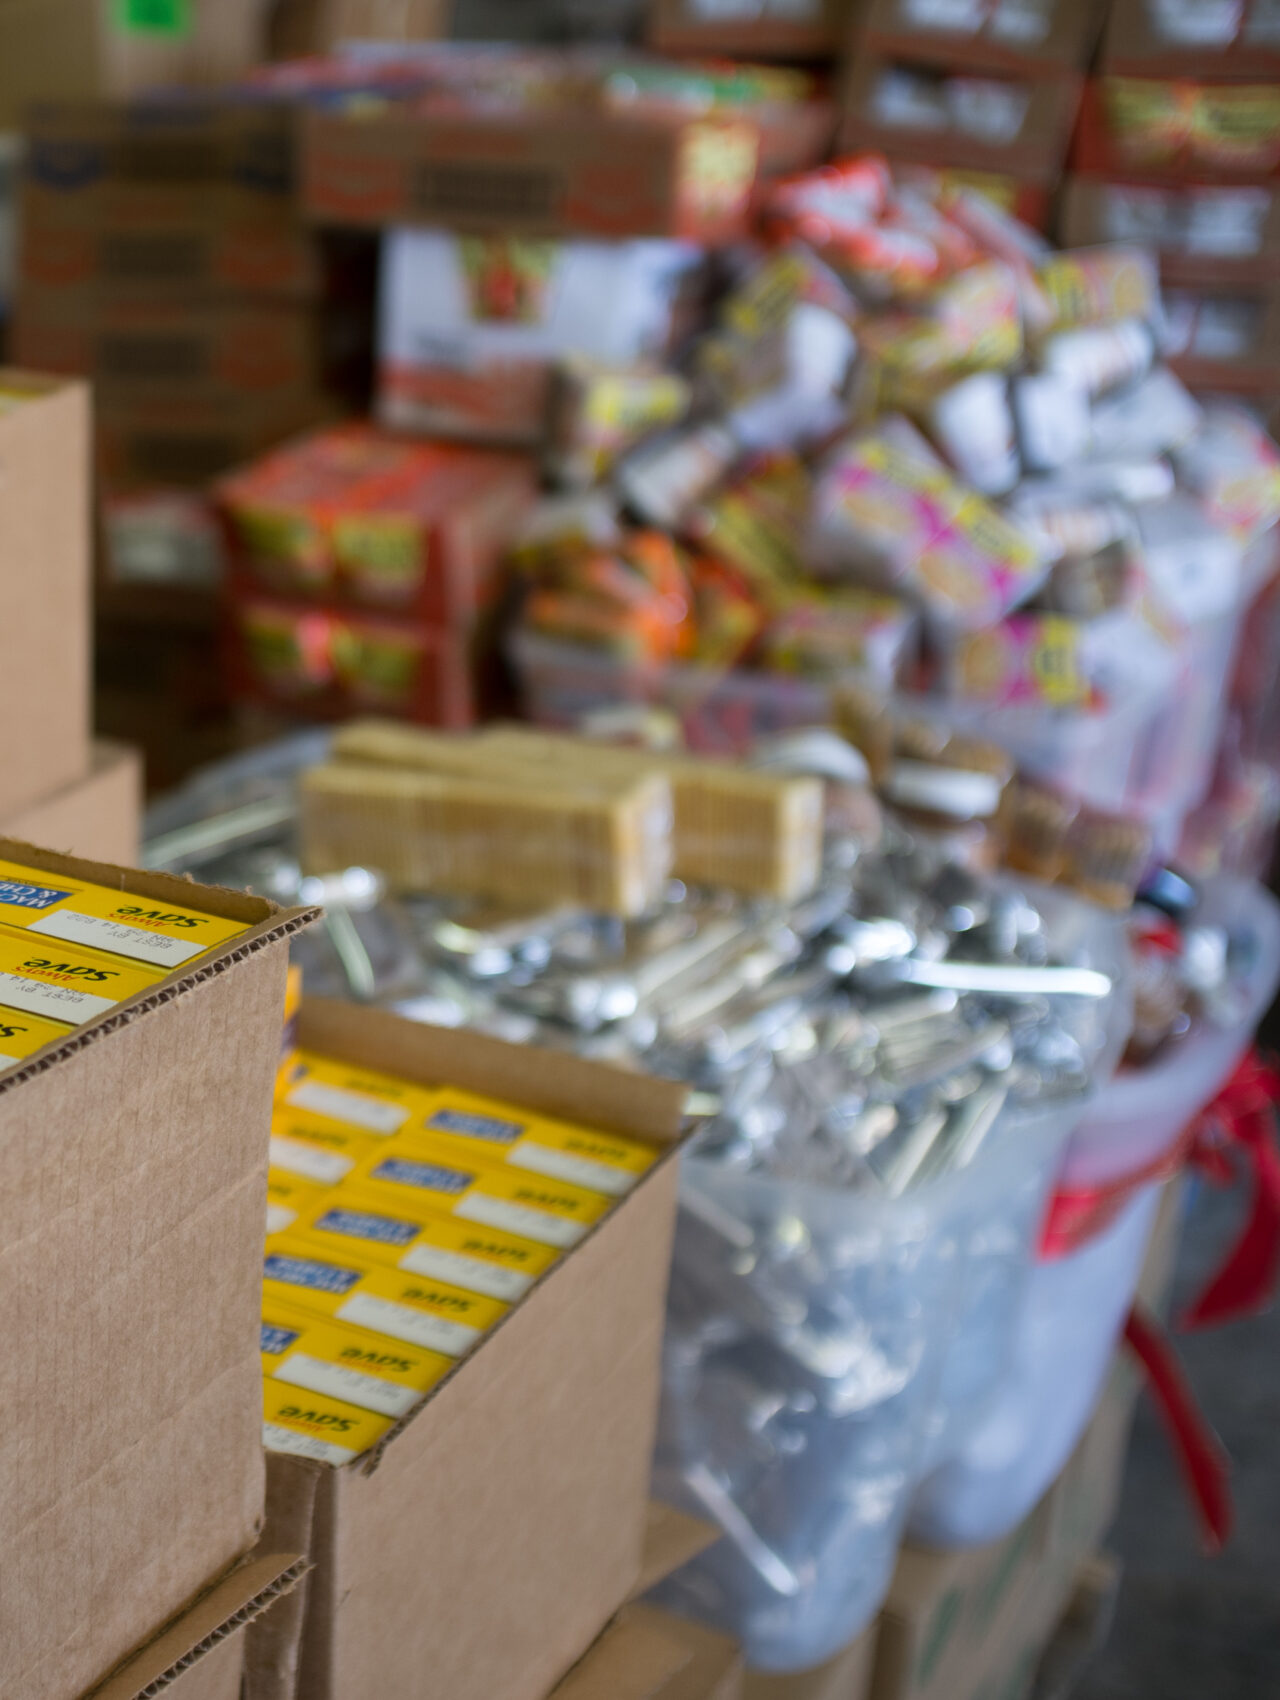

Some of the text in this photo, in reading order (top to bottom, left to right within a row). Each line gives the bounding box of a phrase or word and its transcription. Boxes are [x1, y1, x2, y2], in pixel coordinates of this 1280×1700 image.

[38, 889, 57, 898] &
[116, 906, 209, 927] Save
[23, 958, 120, 981] Save
[11, 983, 86, 1005] BEST BY
[277, 1405, 361, 1432] Save
